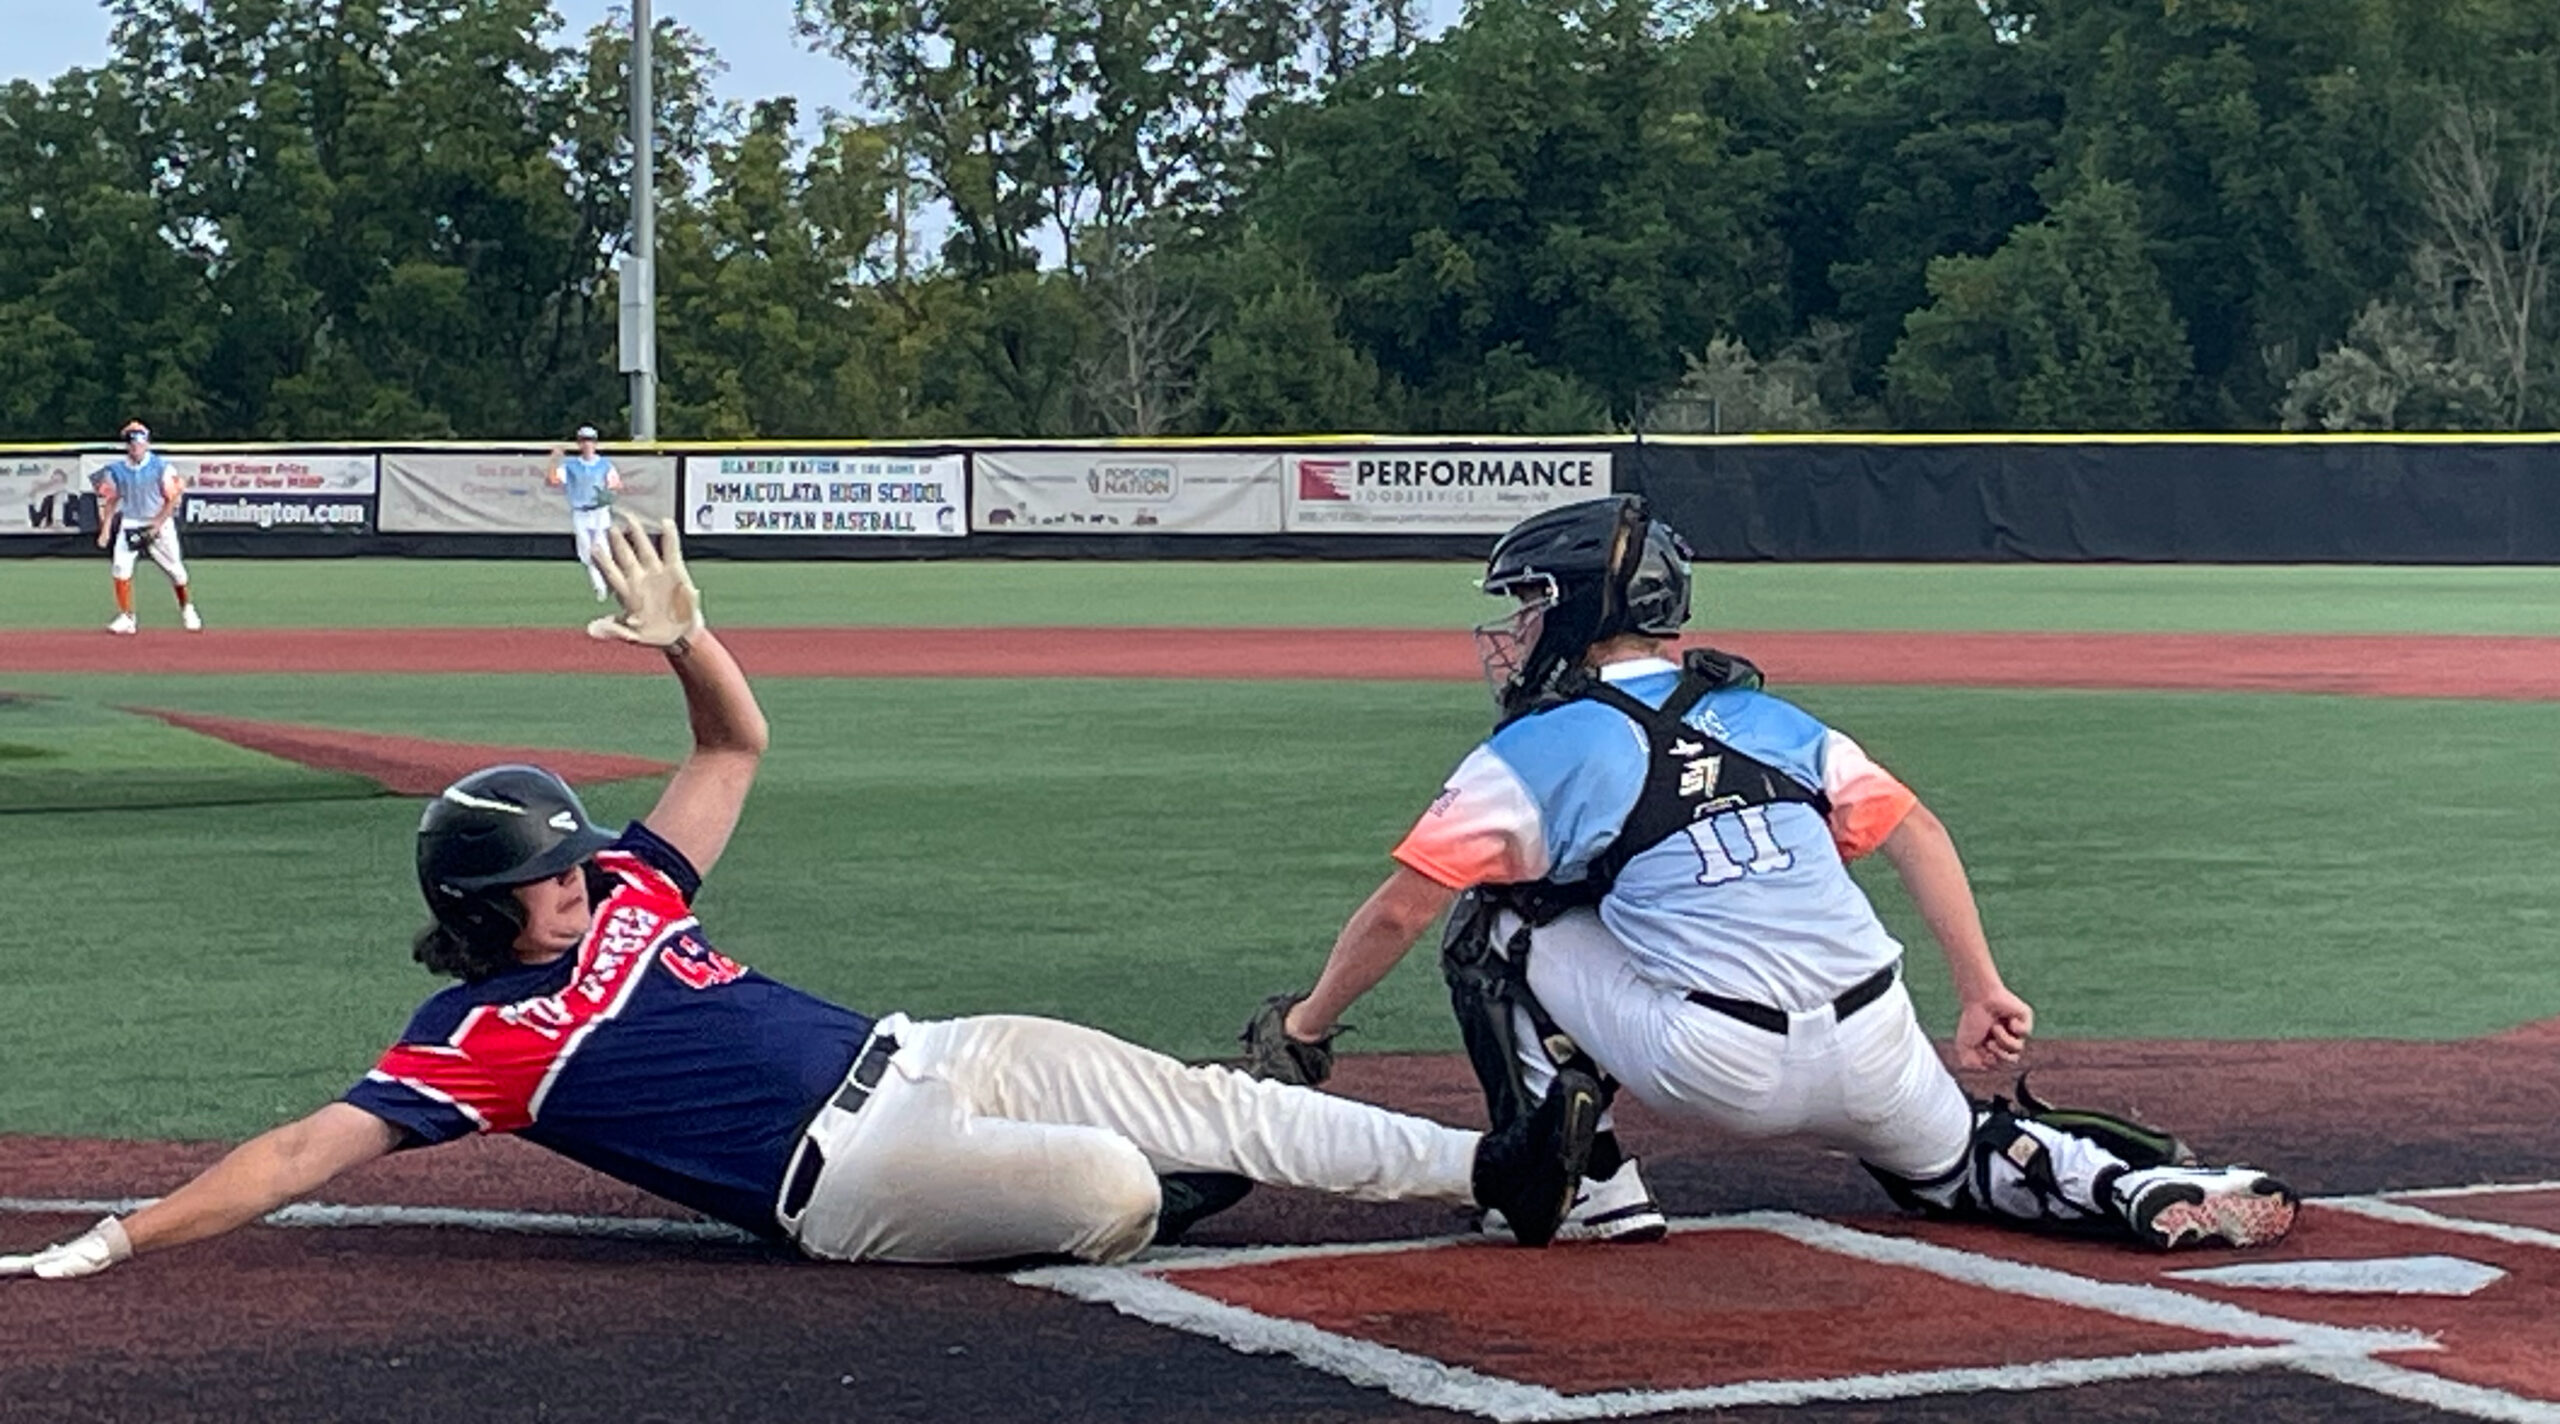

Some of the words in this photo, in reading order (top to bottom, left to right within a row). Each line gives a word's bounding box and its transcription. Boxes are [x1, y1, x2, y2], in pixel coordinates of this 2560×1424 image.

[230, 476, 251, 488] Car
[1105, 467, 1170, 480] POPCORN
[1357, 460, 1593, 487] PERFORMANCE
[706, 482, 823, 503] IMMACULATA
[829, 482, 872, 503] HIGH
[877, 482, 946, 503] SCHOOL
[1105, 479, 1170, 495] NATION
[185, 498, 364, 527] Flemington.com
[735, 511, 816, 530] SPARTAN
[822, 511, 917, 532] BASEBALL
